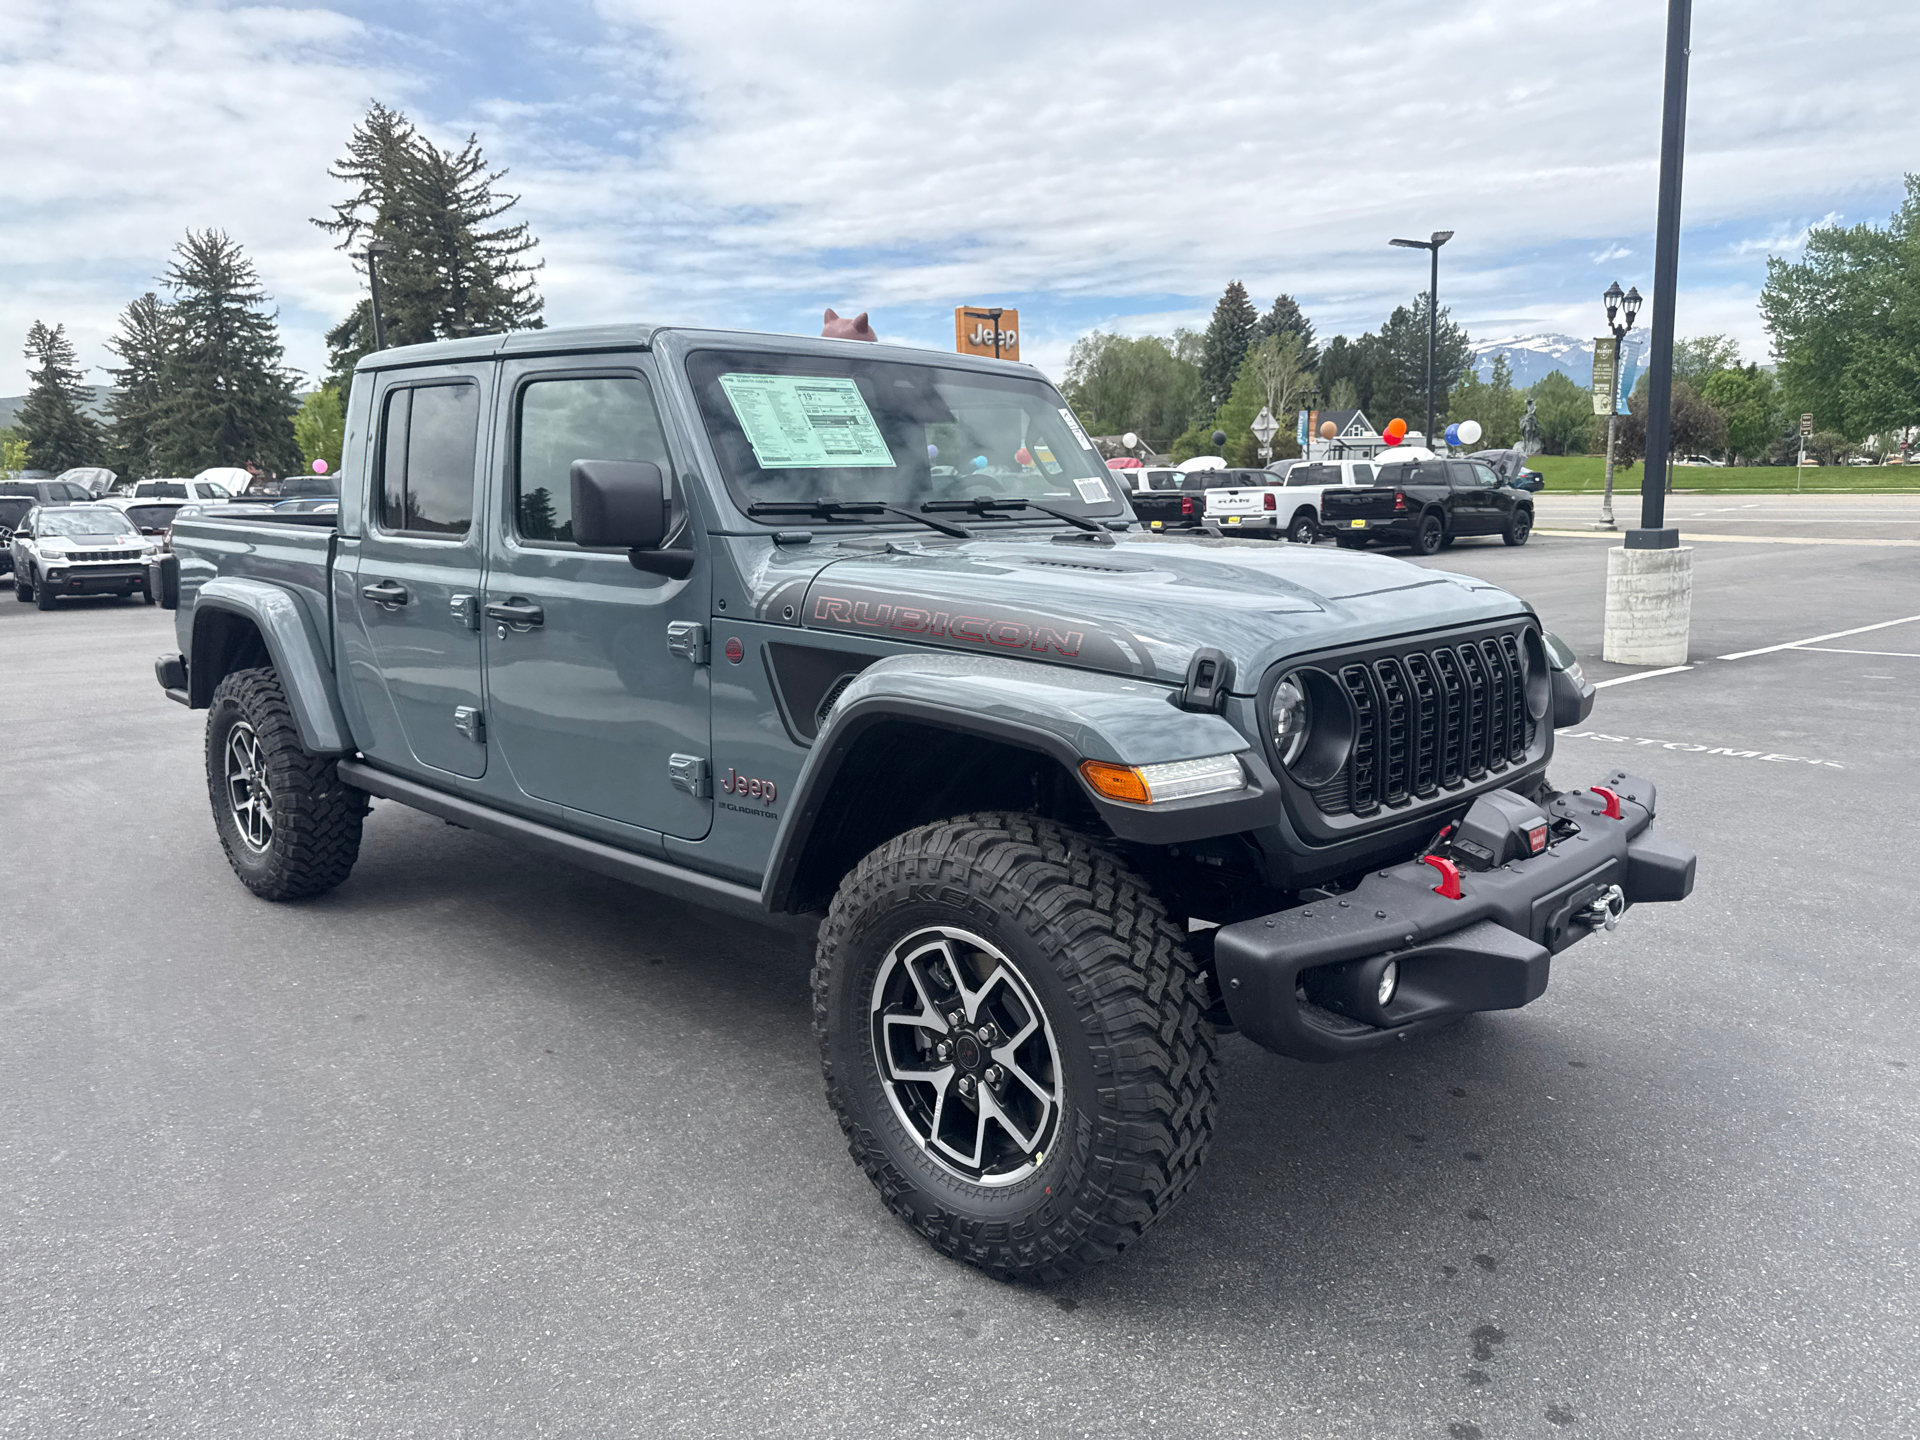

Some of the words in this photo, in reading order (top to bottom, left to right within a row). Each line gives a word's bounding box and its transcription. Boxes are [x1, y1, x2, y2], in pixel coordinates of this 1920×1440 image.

[970, 323, 1017, 350] Jeep
[803, 392, 813, 401] 19
[814, 596, 1084, 657] RUBICON
[720, 767, 778, 807] Jeep
[726, 803, 778, 820] GLADIATOR
